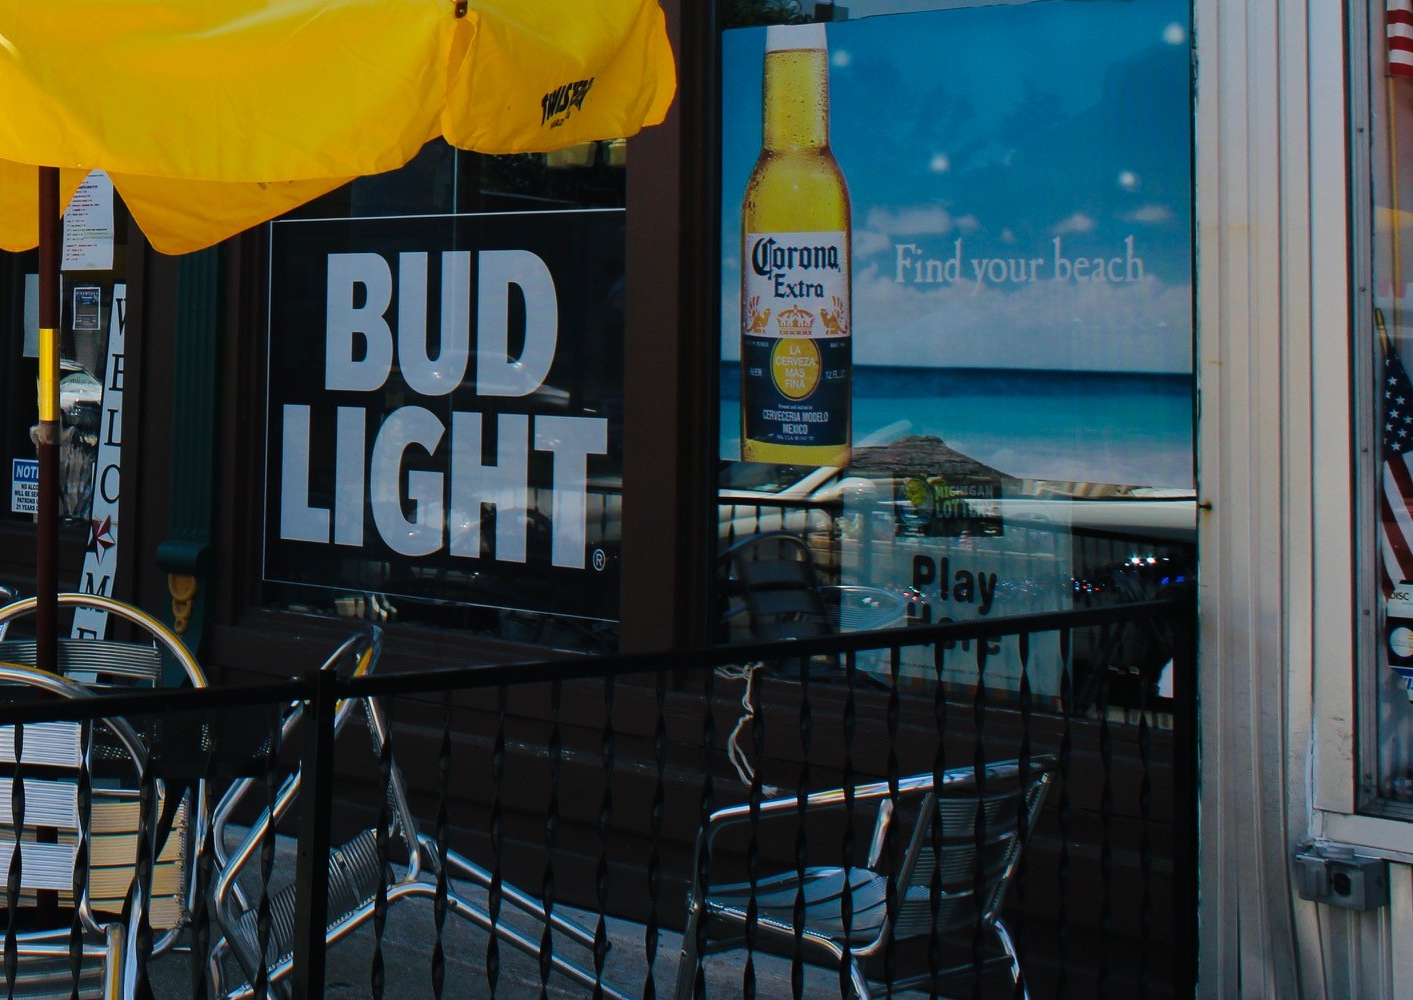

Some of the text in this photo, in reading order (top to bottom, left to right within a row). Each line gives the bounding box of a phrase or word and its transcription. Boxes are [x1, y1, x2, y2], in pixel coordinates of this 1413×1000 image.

[752, 237, 841, 281] Corona
[895, 235, 1144, 297] Find your beach
[774, 273, 824, 299] Extra
[325, 249, 558, 397] BUD
[789, 345, 802, 355] LA
[775, 356, 816, 367] CERVEZA
[785, 368, 805, 378] MAS
[784, 379, 806, 389] FINA
[801, 411, 829, 423] MODELO
[782, 423, 809, 436] MEXICO
[16, 465, 39, 480] NOTI
[280, 403, 608, 570] LIGHT
[934, 484, 994, 500] MICHIGAN
[913, 554, 997, 616] Play
[1391, 591, 1412, 601] DISC
